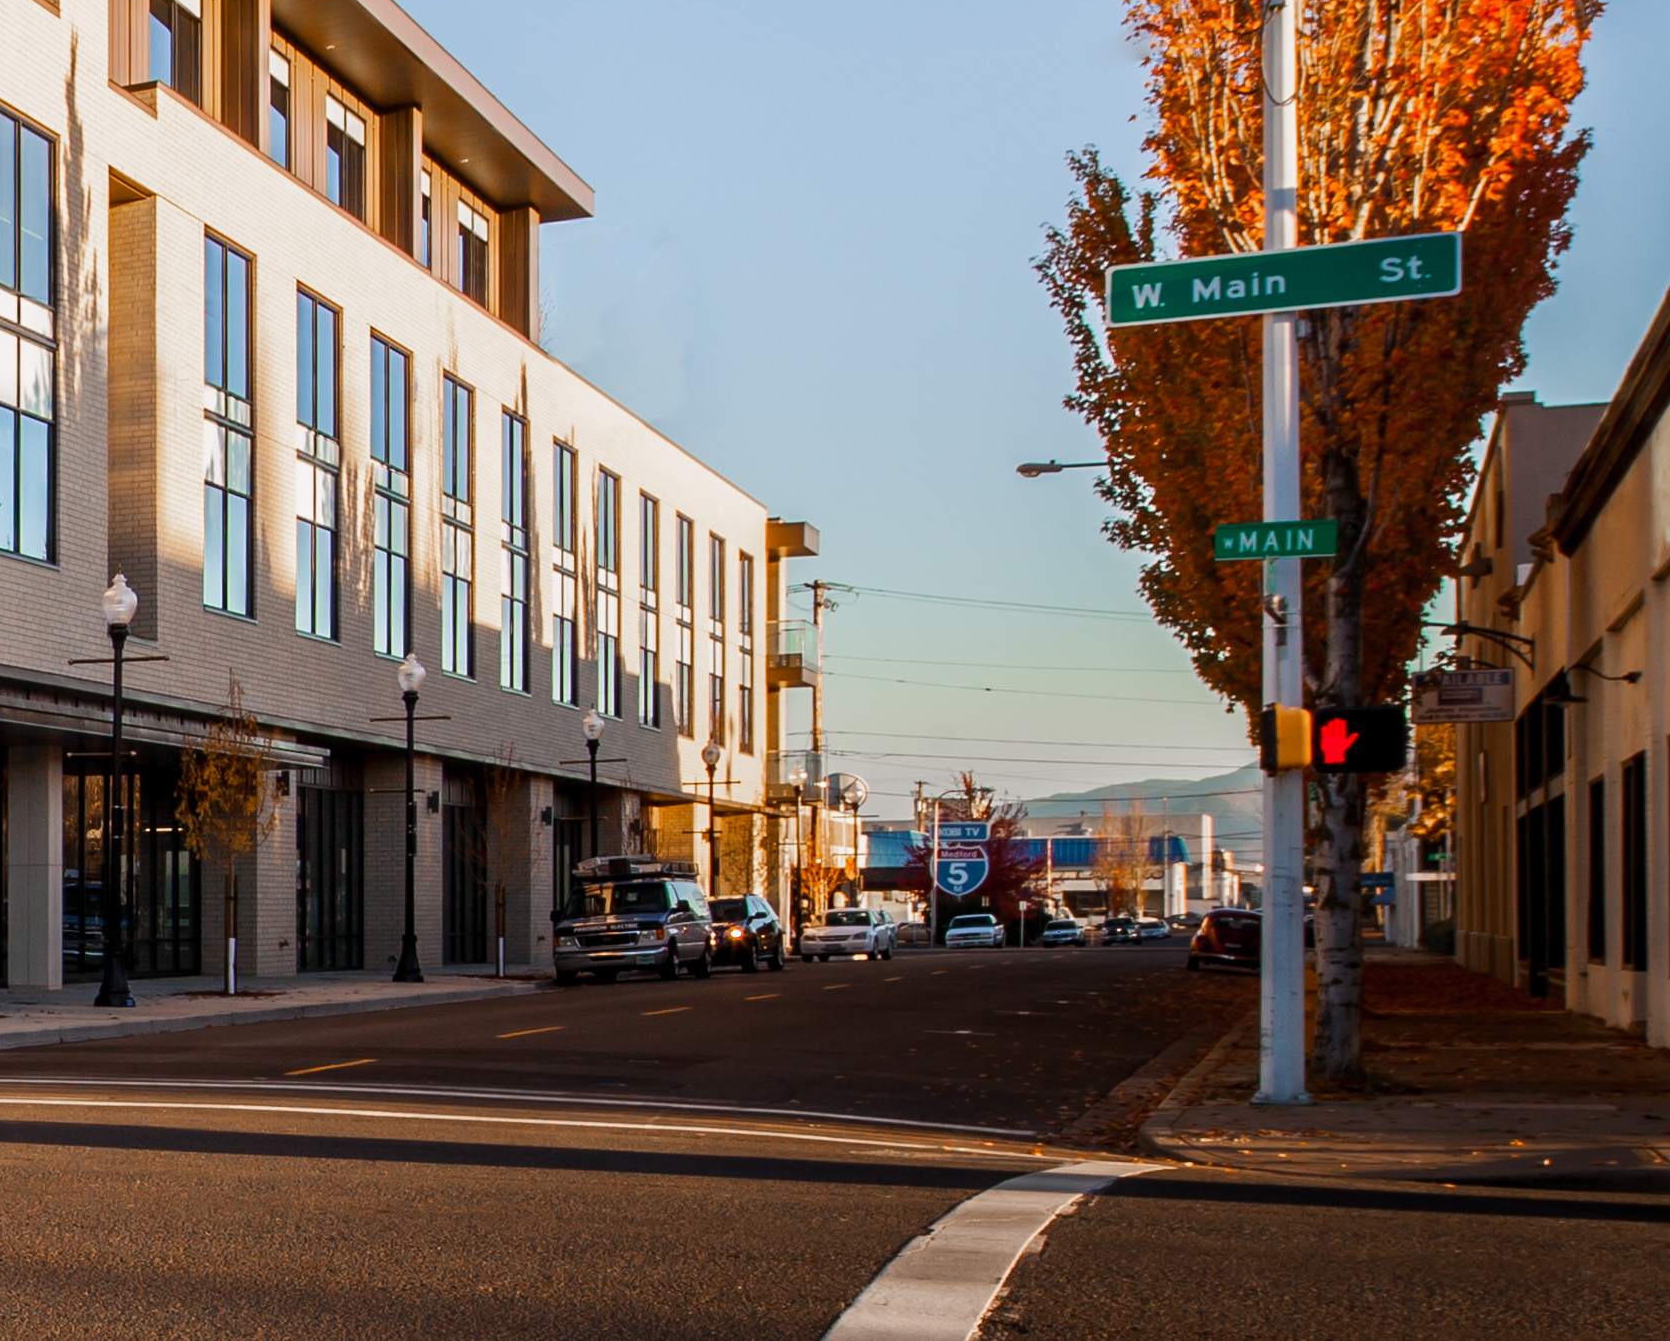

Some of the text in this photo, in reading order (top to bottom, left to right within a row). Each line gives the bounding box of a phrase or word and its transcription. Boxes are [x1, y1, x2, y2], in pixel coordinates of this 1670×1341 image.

[1131, 255, 1431, 309] W. Main St.
[1238, 528, 1314, 553] MAIN
[1425, 672, 1501, 685] AILABLE
[965, 827, 980, 836] TV
[946, 862, 969, 885] 5
